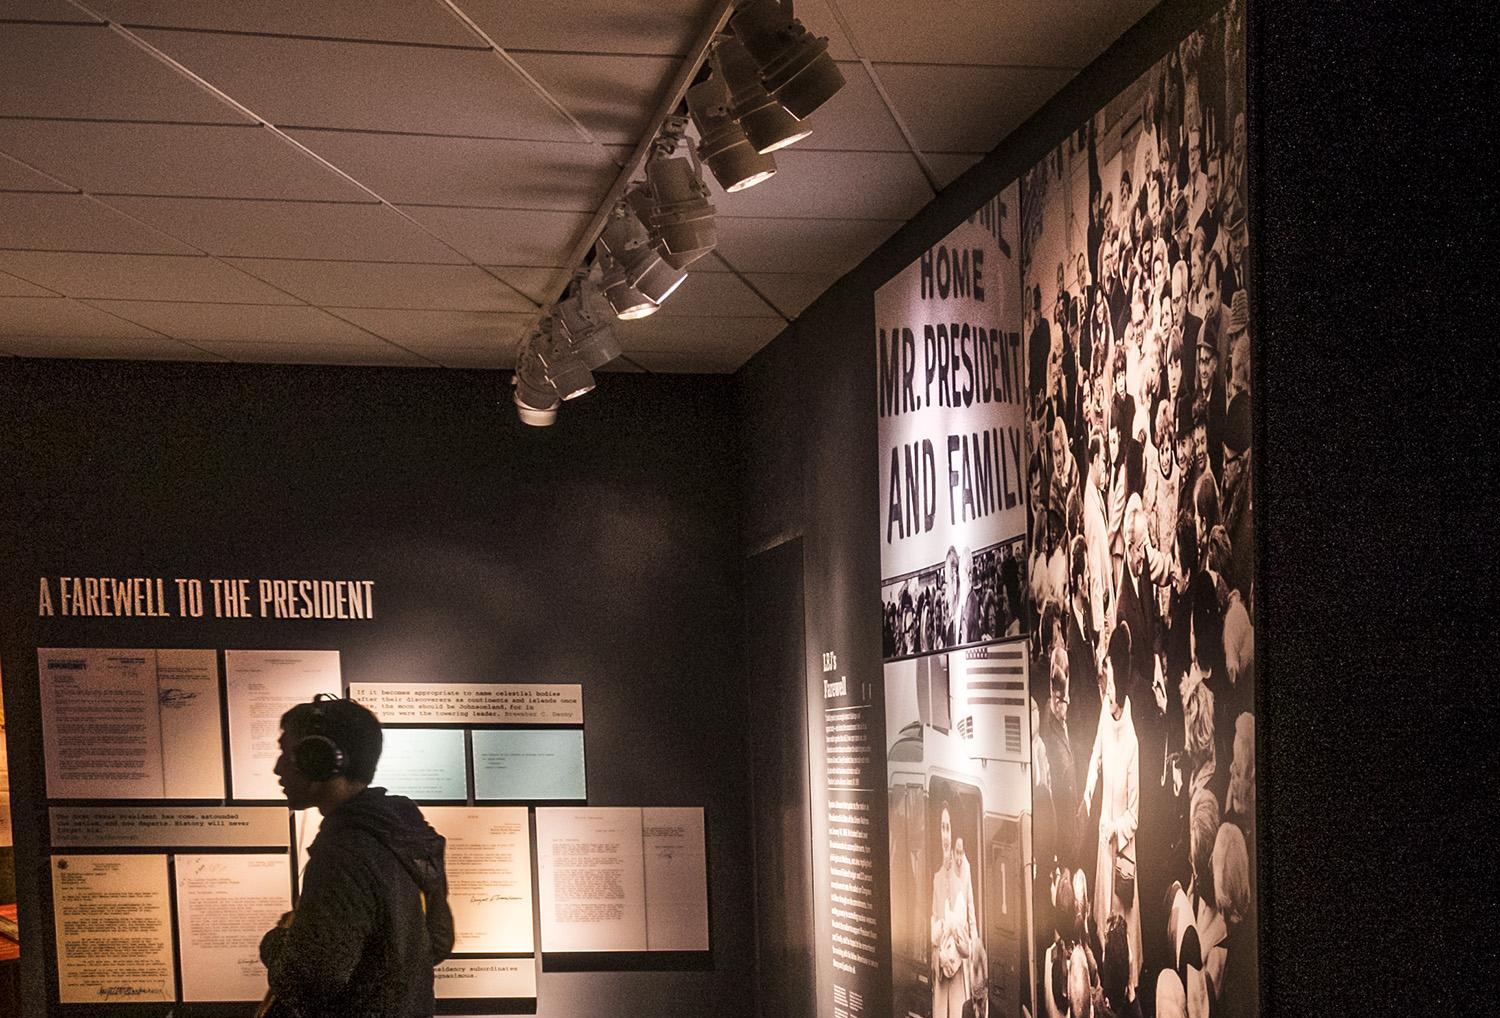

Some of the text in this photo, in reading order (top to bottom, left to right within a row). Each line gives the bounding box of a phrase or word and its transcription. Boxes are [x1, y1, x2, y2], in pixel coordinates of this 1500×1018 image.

[920, 245, 985, 302] HOME
[879, 322, 1020, 418] MR. PRESIDENT
[887, 426, 1024, 545] AND FAMILY
[38, 577, 375, 619] A FAREWELL TO THE PRESIDENT
